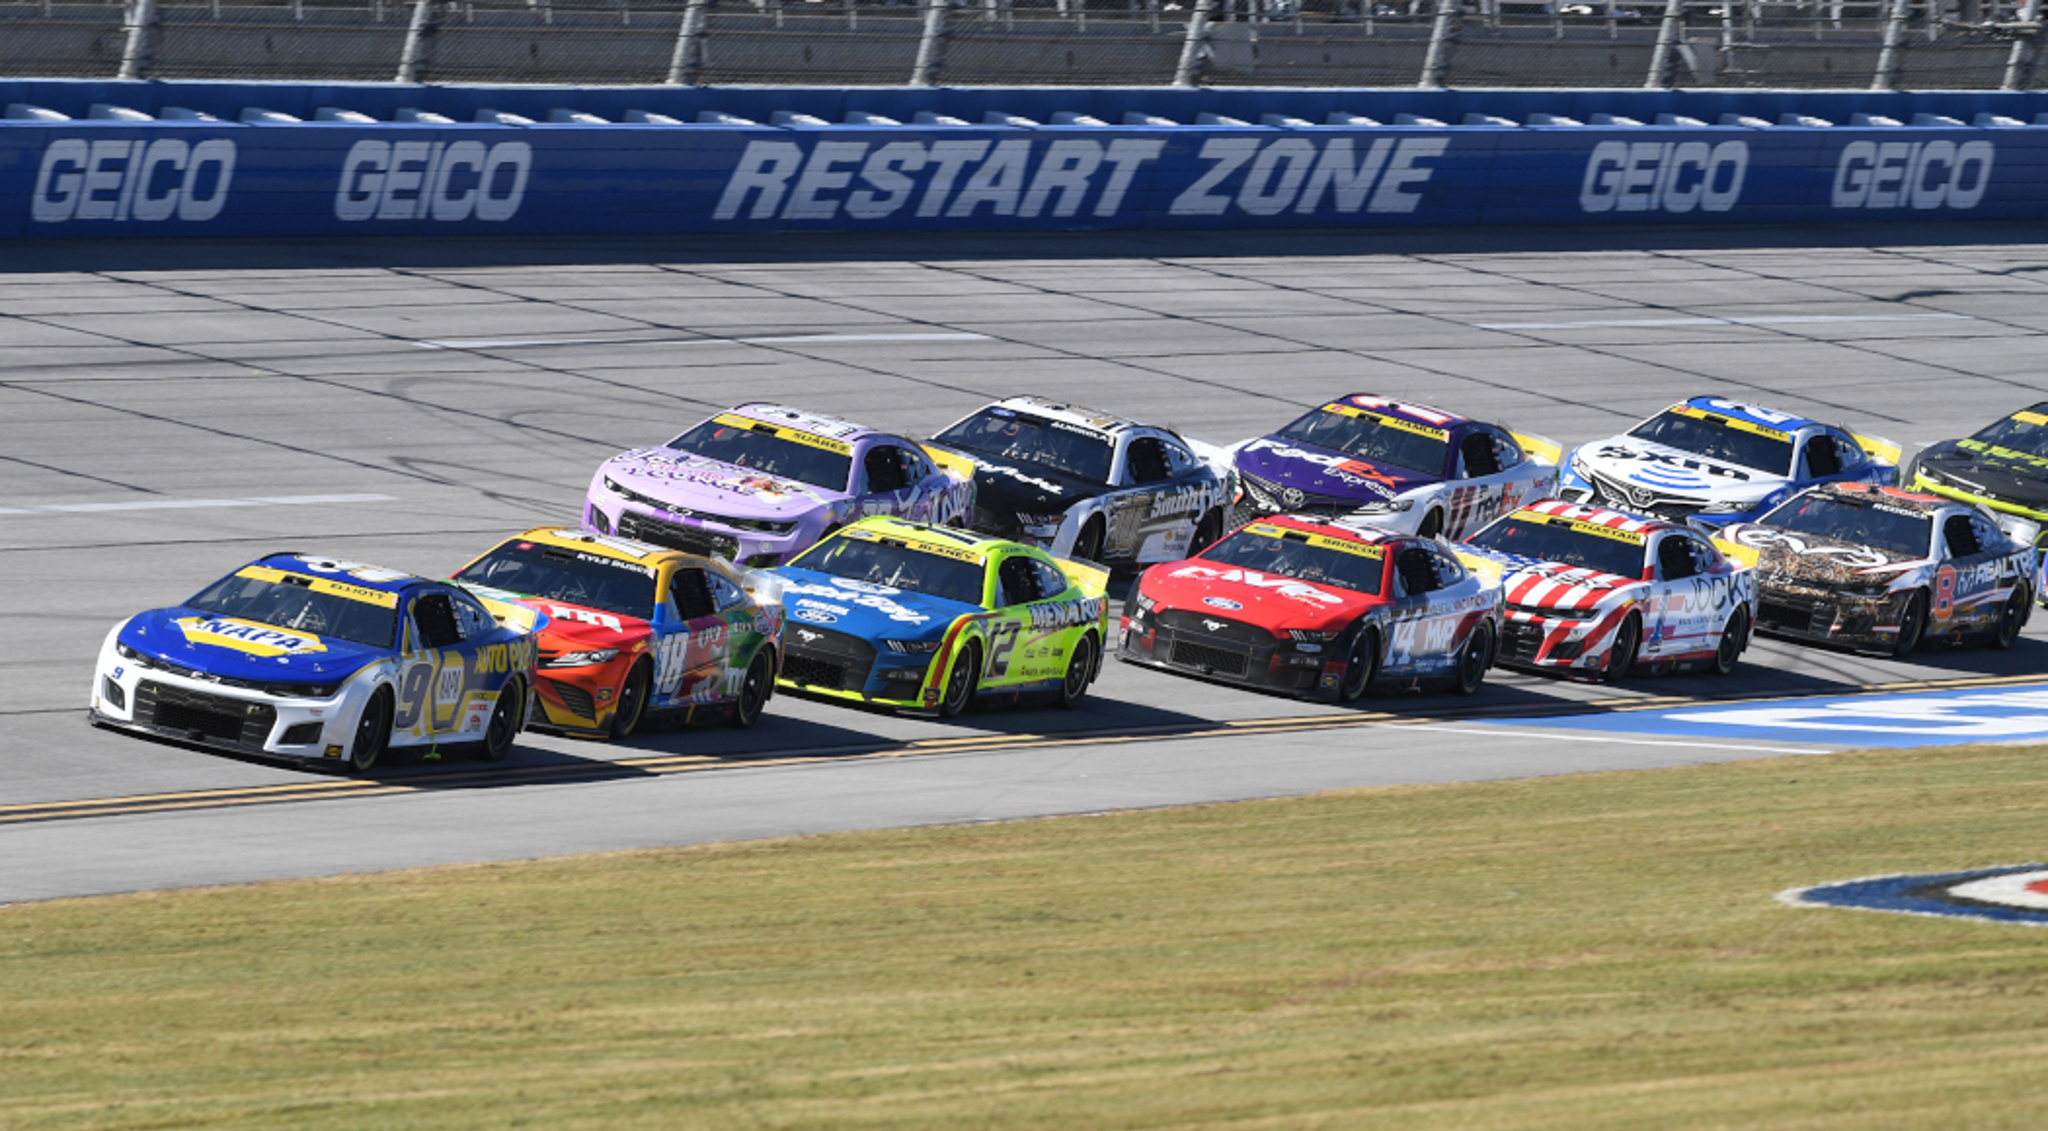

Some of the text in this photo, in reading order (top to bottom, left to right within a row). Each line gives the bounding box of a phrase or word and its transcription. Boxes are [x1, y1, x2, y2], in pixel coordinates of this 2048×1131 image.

[32, 138, 237, 222] GEICO
[335, 139, 532, 220] GEICO
[712, 137, 1451, 220] RESTART ZONE
[1579, 140, 1750, 213] GEICO
[1832, 140, 1995, 210] GEICO
[1394, 419, 1444, 436] HAMLIN
[1755, 425, 1786, 438] BELL
[1244, 439, 1405, 488] FedEx
[1323, 467, 1398, 500] Express
[1872, 503, 1928, 520] REDDICK
[1574, 521, 1640, 542] CHASTAIN
[577, 552, 610, 565] KYLE
[918, 543, 972, 560] BLANEY
[330, 583, 385, 600] ELLIOTT
[1935, 564, 1956, 621] 8
[198, 621, 304, 650] NAPA
[985, 618, 1022, 680] 12
[1384, 609, 1422, 667] 14
[1424, 618, 1456, 650] MVP
[111, 666, 124, 680] 9
[474, 644, 508, 673] AUTO
[396, 662, 434, 729] 9
